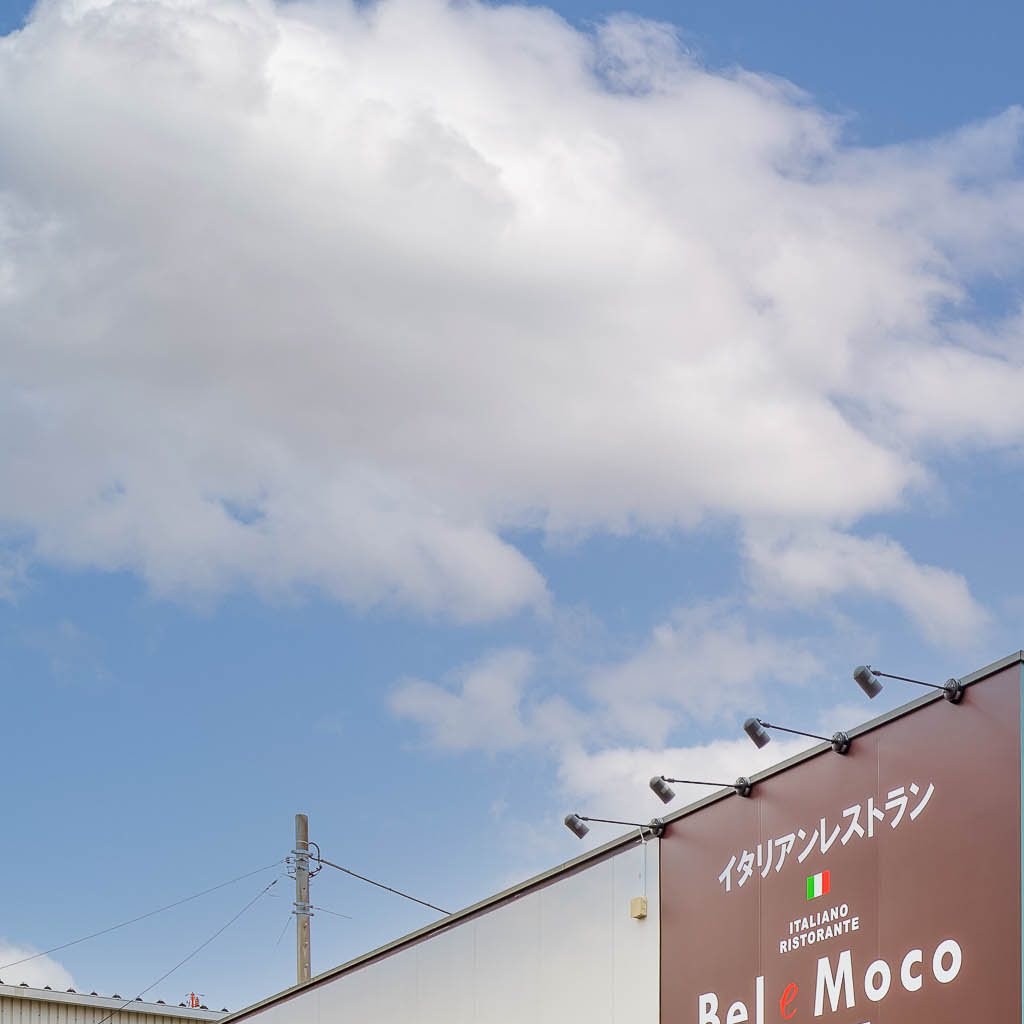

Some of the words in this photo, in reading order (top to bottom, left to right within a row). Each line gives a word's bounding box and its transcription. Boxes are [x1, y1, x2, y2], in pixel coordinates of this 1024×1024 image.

[718, 782, 935, 892] イタリアンレストラン
[779, 916, 860, 954] RISTORANTE
[789, 903, 849, 935] ITALIANO
[779, 983, 799, 1019] e
[813, 939, 963, 1017] Moco
